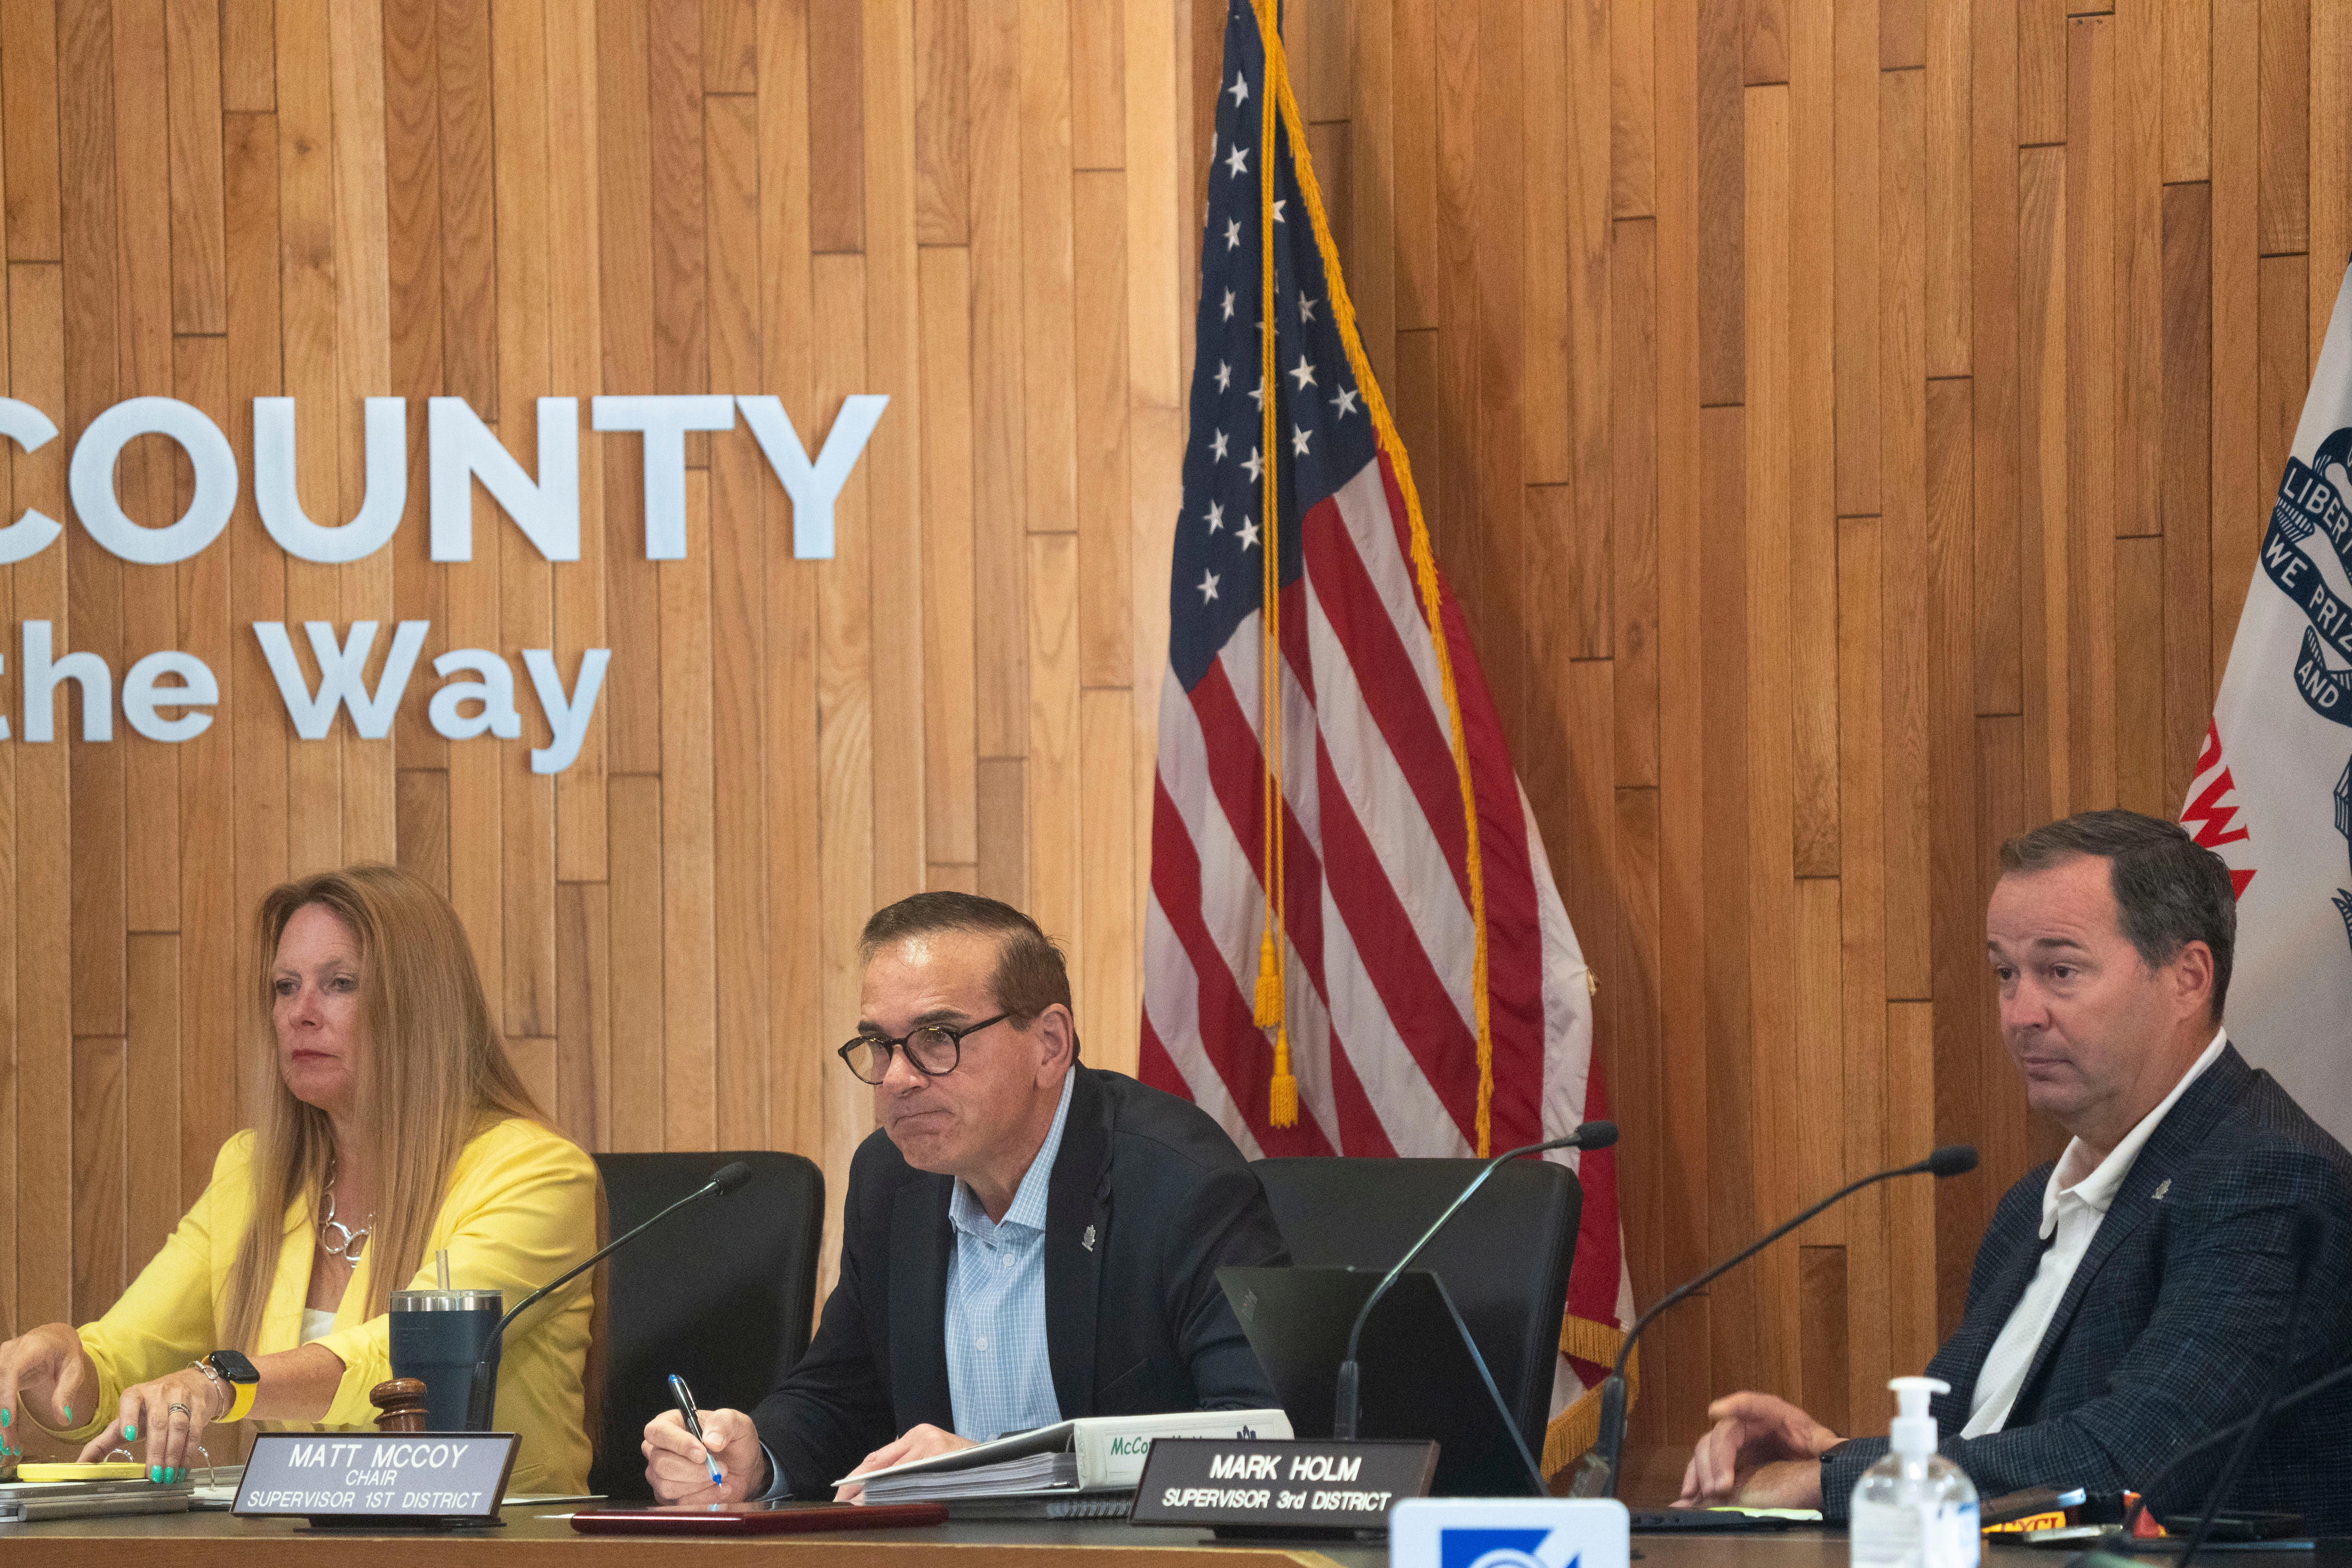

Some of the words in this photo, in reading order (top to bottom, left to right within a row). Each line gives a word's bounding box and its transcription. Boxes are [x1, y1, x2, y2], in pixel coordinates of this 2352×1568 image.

[2266, 533, 2308, 588] WE
[2298, 659, 2339, 707] AND
[0, 620, 219, 742] he
[253, 620, 612, 775] Way
[288, 1444, 363, 1468] MATT
[370, 1444, 469, 1468] MCCOY
[1111, 1437, 1152, 1455] McCo
[345, 1470, 398, 1486] CHAIR
[1209, 1454, 1282, 1480] MARK
[1289, 1456, 1362, 1481] HOLM
[247, 1491, 356, 1508] SUPERVISOR
[365, 1491, 396, 1509] 1ST
[401, 1491, 483, 1509] DISTRICT
[1162, 1487, 1271, 1508] SUPERVISOR
[1276, 1490, 1307, 1509] 3rd
[1311, 1491, 1392, 1512] DISTRICT
